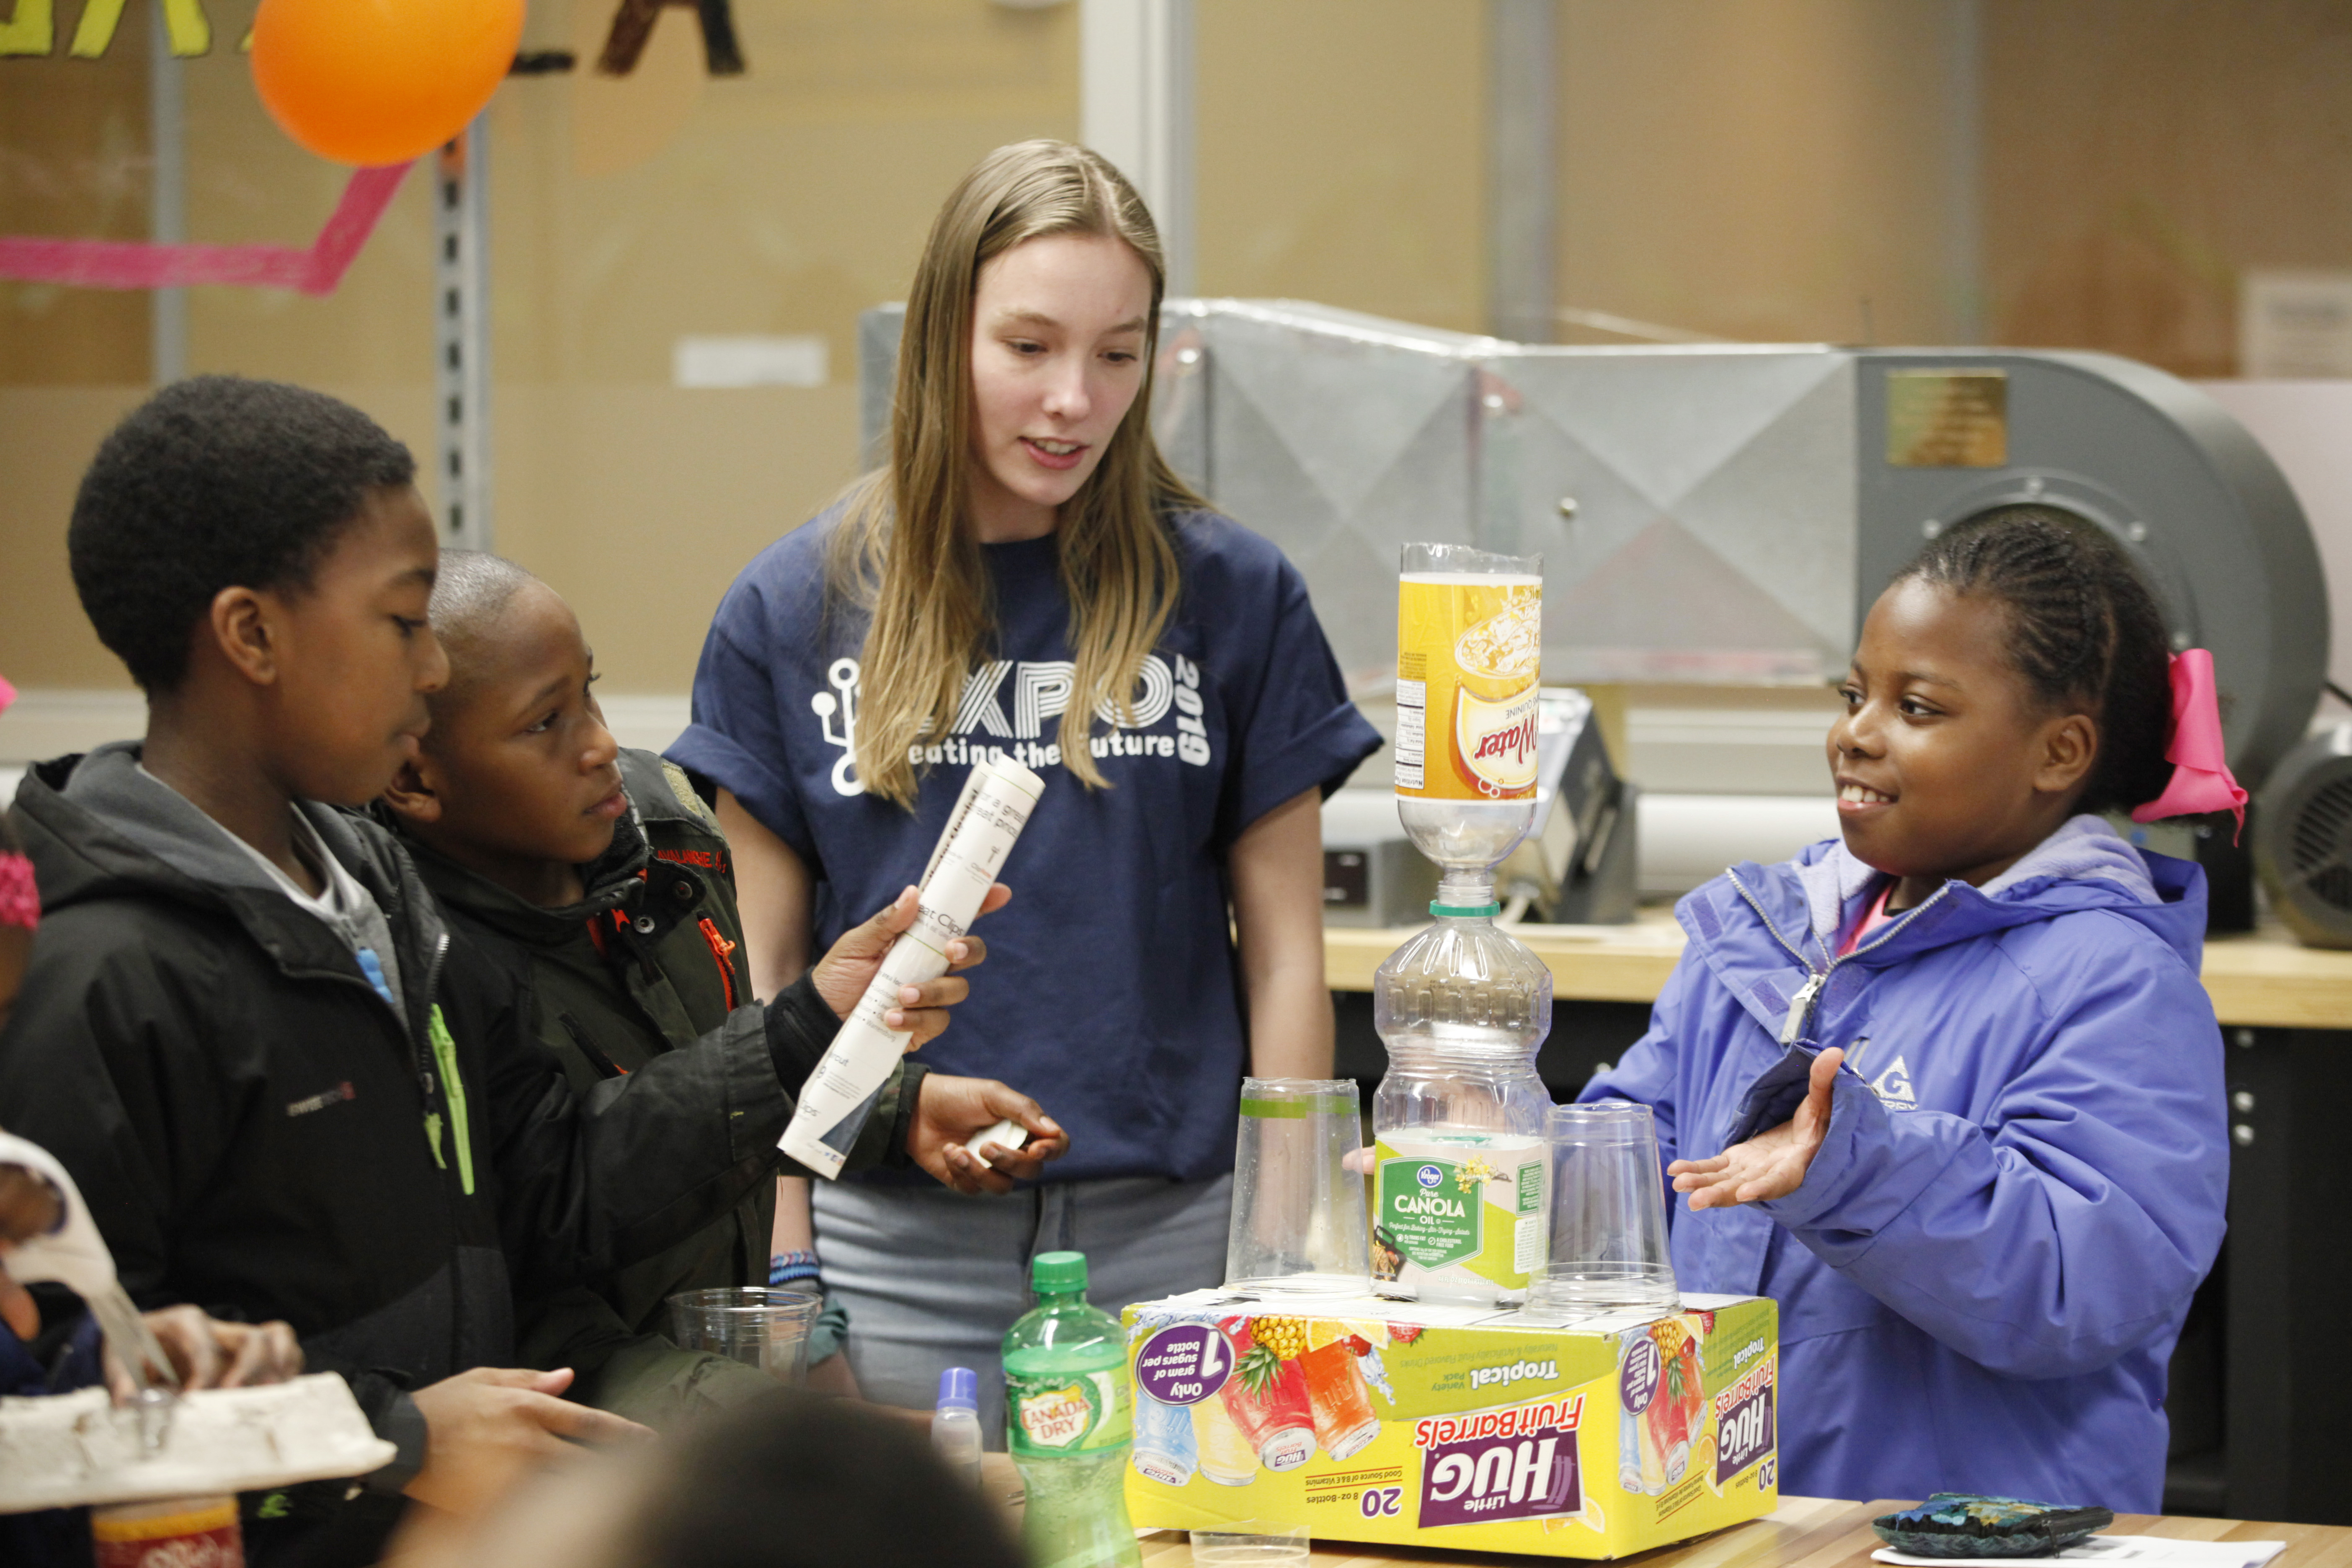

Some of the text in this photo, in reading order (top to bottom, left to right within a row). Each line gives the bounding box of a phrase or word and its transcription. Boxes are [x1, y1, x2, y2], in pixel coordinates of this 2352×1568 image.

[921, 655, 1173, 739] XPO
[1175, 655, 1210, 767] 2019
[1506, 699, 1533, 720] QUININE
[1474, 713, 1537, 765] Water
[908, 732, 1175, 769] eating the uture
[1402, 777, 1423, 786] Nutrition
[658, 849, 712, 868] AVALANCHE
[918, 904, 936, 919] eat
[938, 914, 963, 936] Clips
[882, 972, 893, 982] area
[1421, 1168, 1440, 1184] Kroger
[1420, 1188, 1439, 1198] Pure
[1394, 1195, 1466, 1218] CANOLA
[1420, 1215, 1434, 1225] OIL
[1166, 1341, 1200, 1354] bottle
[1202, 1331, 1222, 1377] 1
[1733, 1337, 1764, 1370] Tropical
[1142, 1353, 1198, 1367] sugars per
[1647, 1344, 1656, 1386] 1
[1153, 1364, 1196, 1381] gram of
[1443, 1372, 1465, 1382] Pack
[1470, 1359, 1559, 1390] Tropical
[1751, 1358, 1775, 1397] Fruit
[1170, 1382, 1203, 1398] Only
[1431, 1381, 1465, 1391] Variety
[1634, 1392, 1648, 1409] Only
[1715, 1378, 1751, 1419] Barrels
[1020, 1397, 1091, 1430] CANADA
[1518, 1395, 1585, 1436] Fruit
[1041, 1418, 1075, 1439] DRY
[1415, 1409, 1519, 1449] Barrels
[1720, 1392, 1765, 1461] HUG
[1276, 1442, 1302, 1452] Barrels
[1276, 1451, 1302, 1464] HUG
[1732, 1447, 1749, 1465] Little
[1360, 1471, 1383, 1480] Source
[1384, 1470, 1402, 1479] Good
[1429, 1437, 1559, 1504] HUG
[1759, 1458, 1775, 1492] 20
[1305, 1477, 1335, 1486] Vitamins
[1361, 1487, 1402, 1518] 20
[1463, 1495, 1506, 1513] Little
